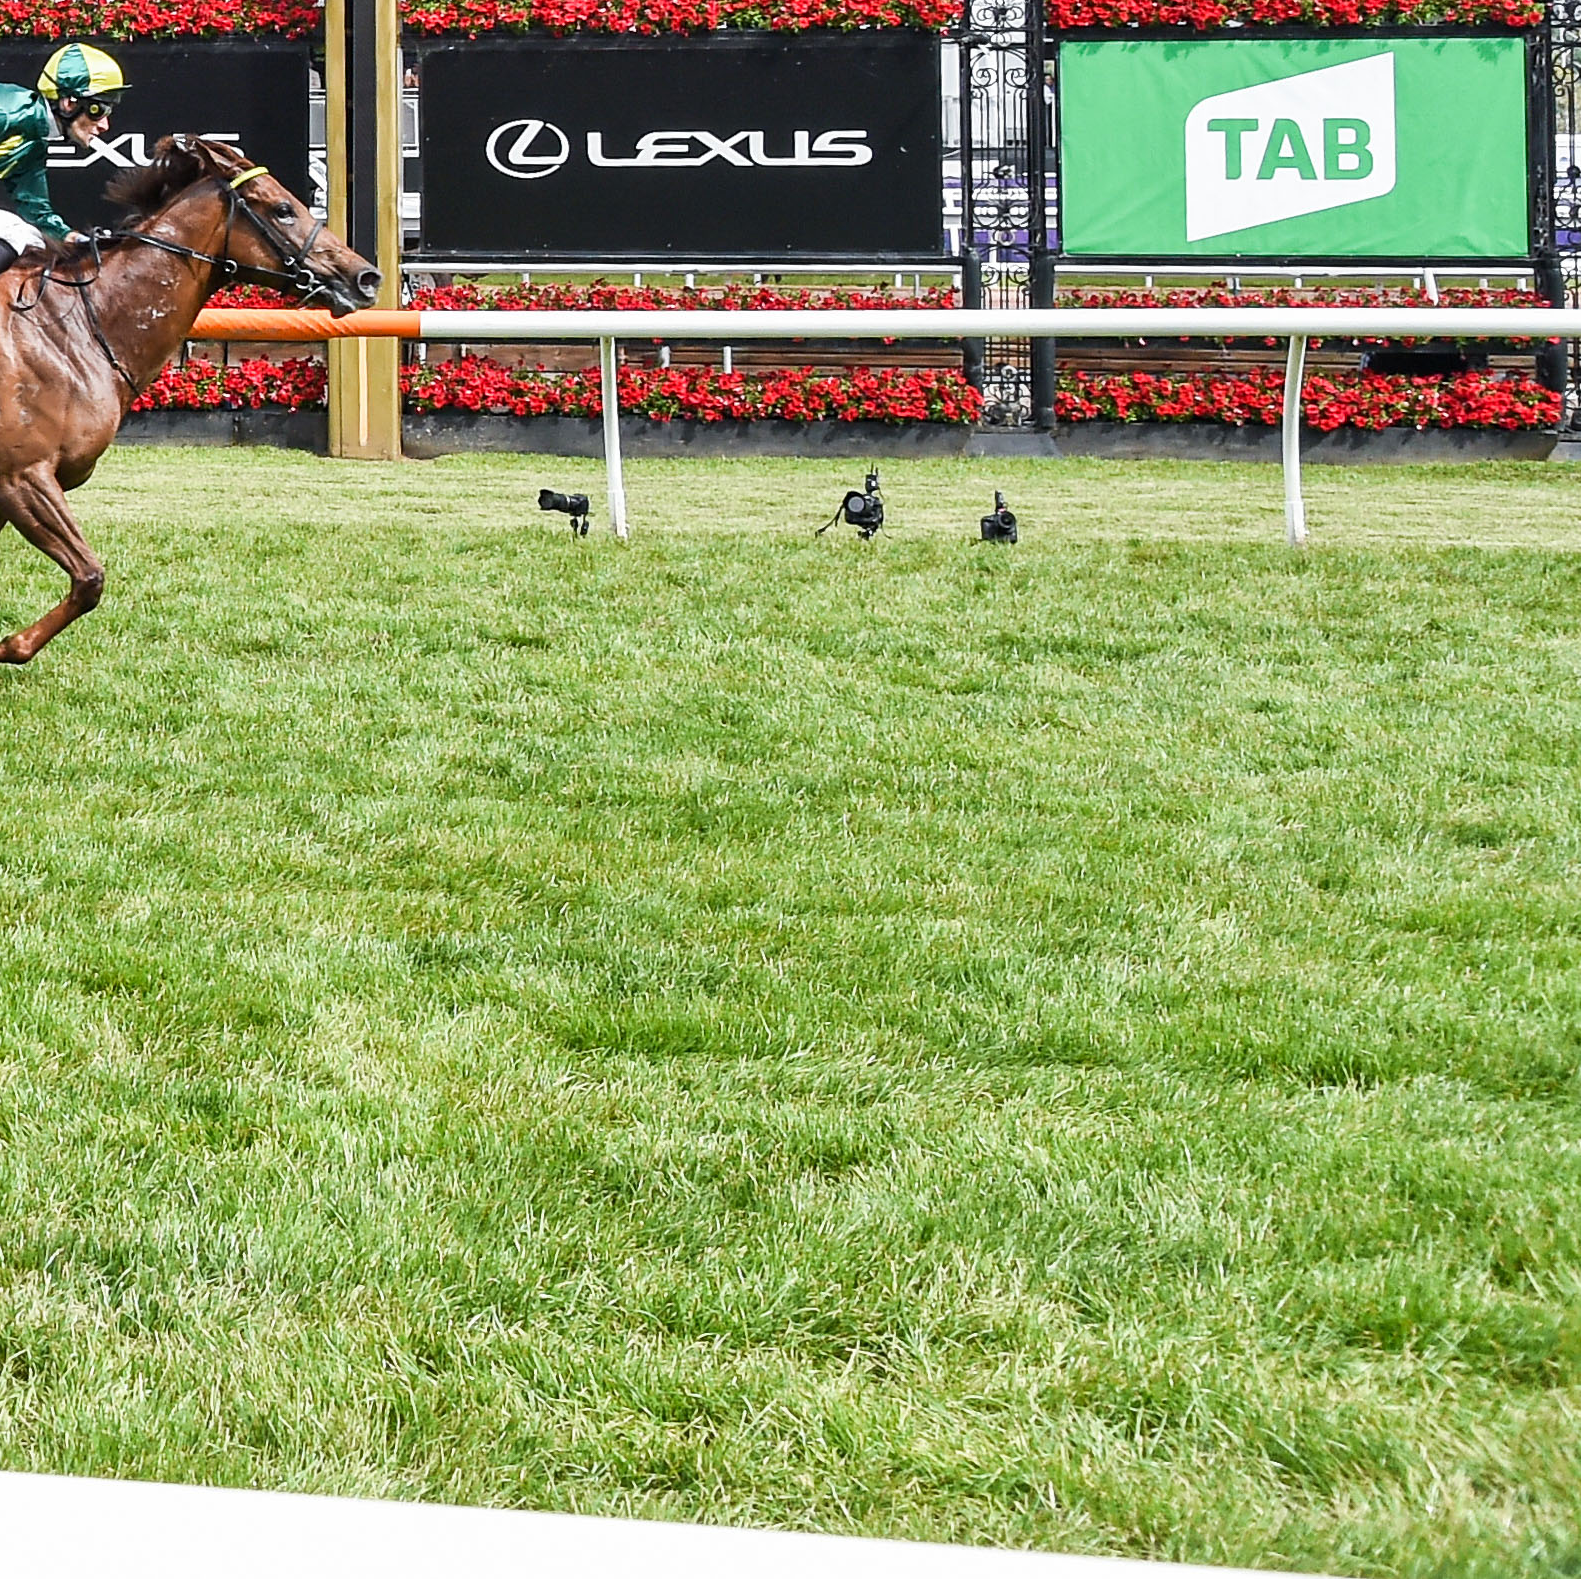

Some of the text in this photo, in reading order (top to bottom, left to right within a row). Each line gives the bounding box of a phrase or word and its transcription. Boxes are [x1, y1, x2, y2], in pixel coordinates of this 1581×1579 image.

[44, 133, 245, 168] EXU
[587, 130, 873, 167] LEXUS
[1207, 118, 1374, 180] TAB
